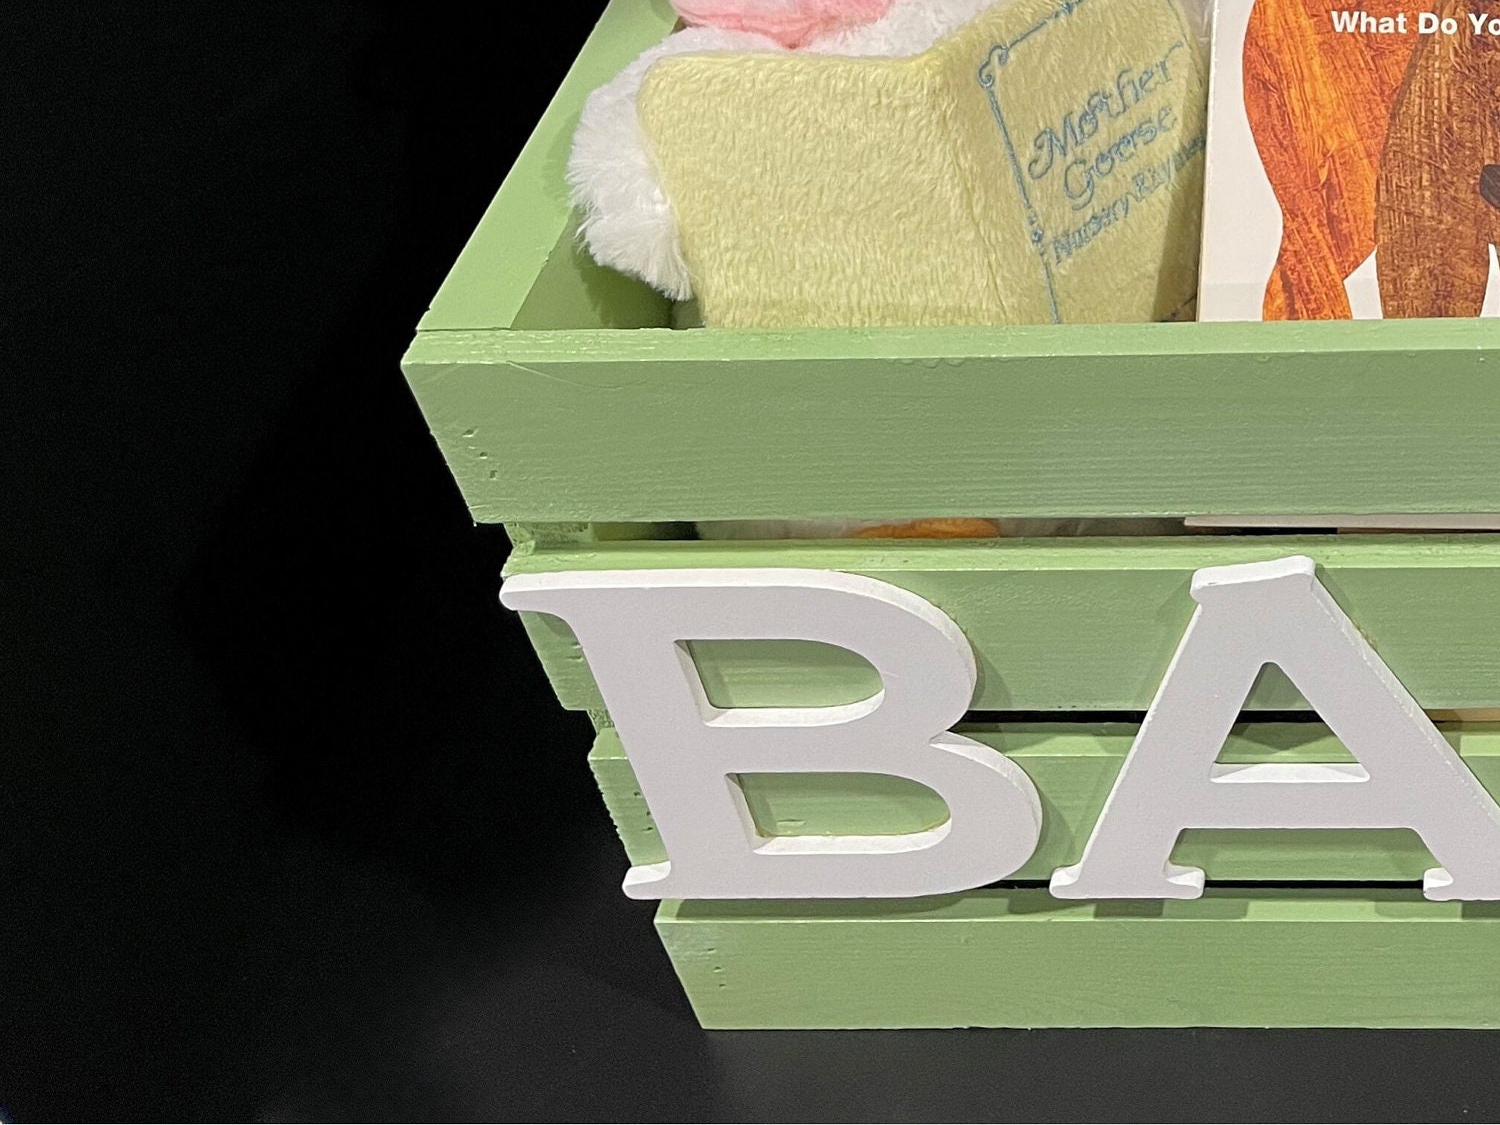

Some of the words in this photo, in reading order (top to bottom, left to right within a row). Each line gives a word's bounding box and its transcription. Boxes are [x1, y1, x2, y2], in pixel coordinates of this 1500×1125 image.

[1331, 10, 1408, 35] What
[1418, 12, 1459, 36] Do
[1028, 42, 1184, 180] Mother
[1063, 105, 1177, 211] Goose
